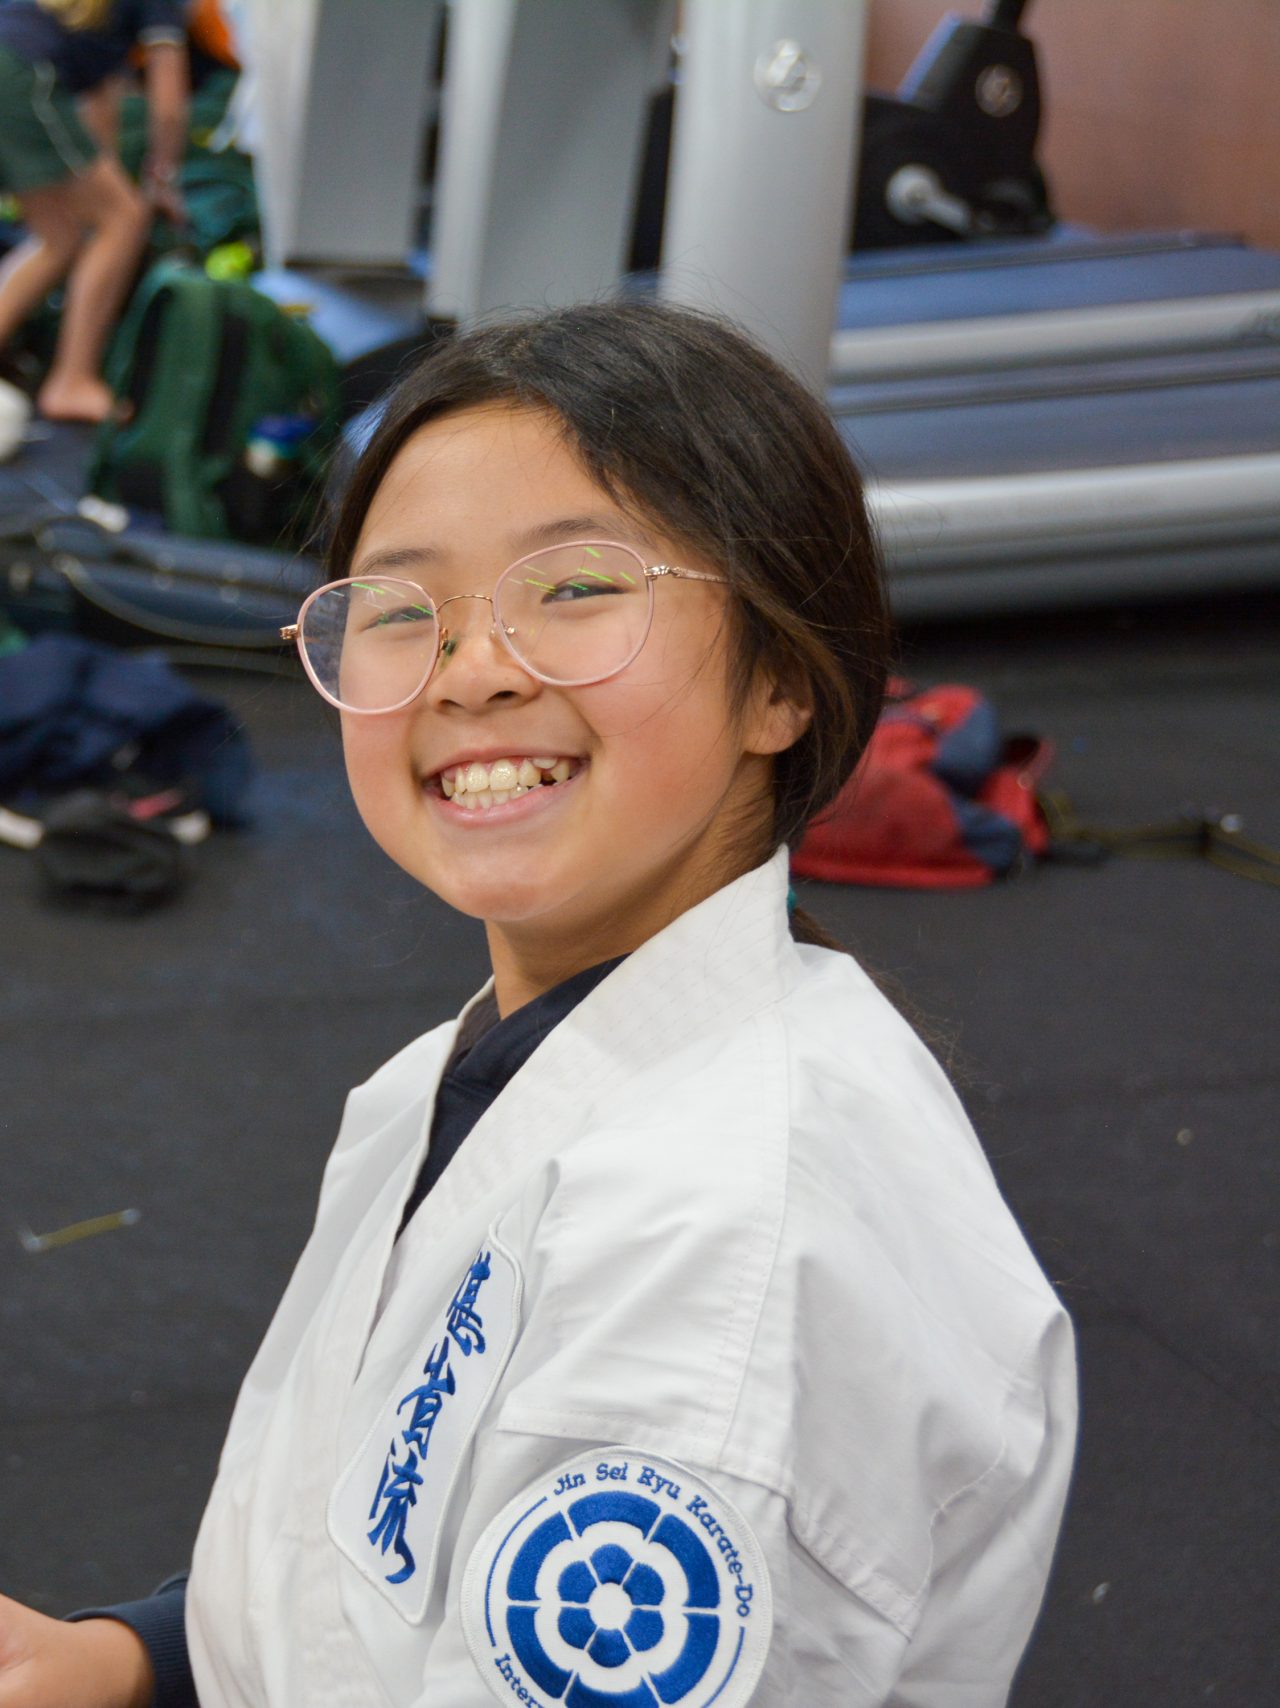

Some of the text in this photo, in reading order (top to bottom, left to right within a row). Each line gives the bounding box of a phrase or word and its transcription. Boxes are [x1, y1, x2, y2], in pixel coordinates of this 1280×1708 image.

[553, 1462, 753, 1617] Jin Sei Ryu Karate-Do
[494, 1653, 543, 1708] Inter
